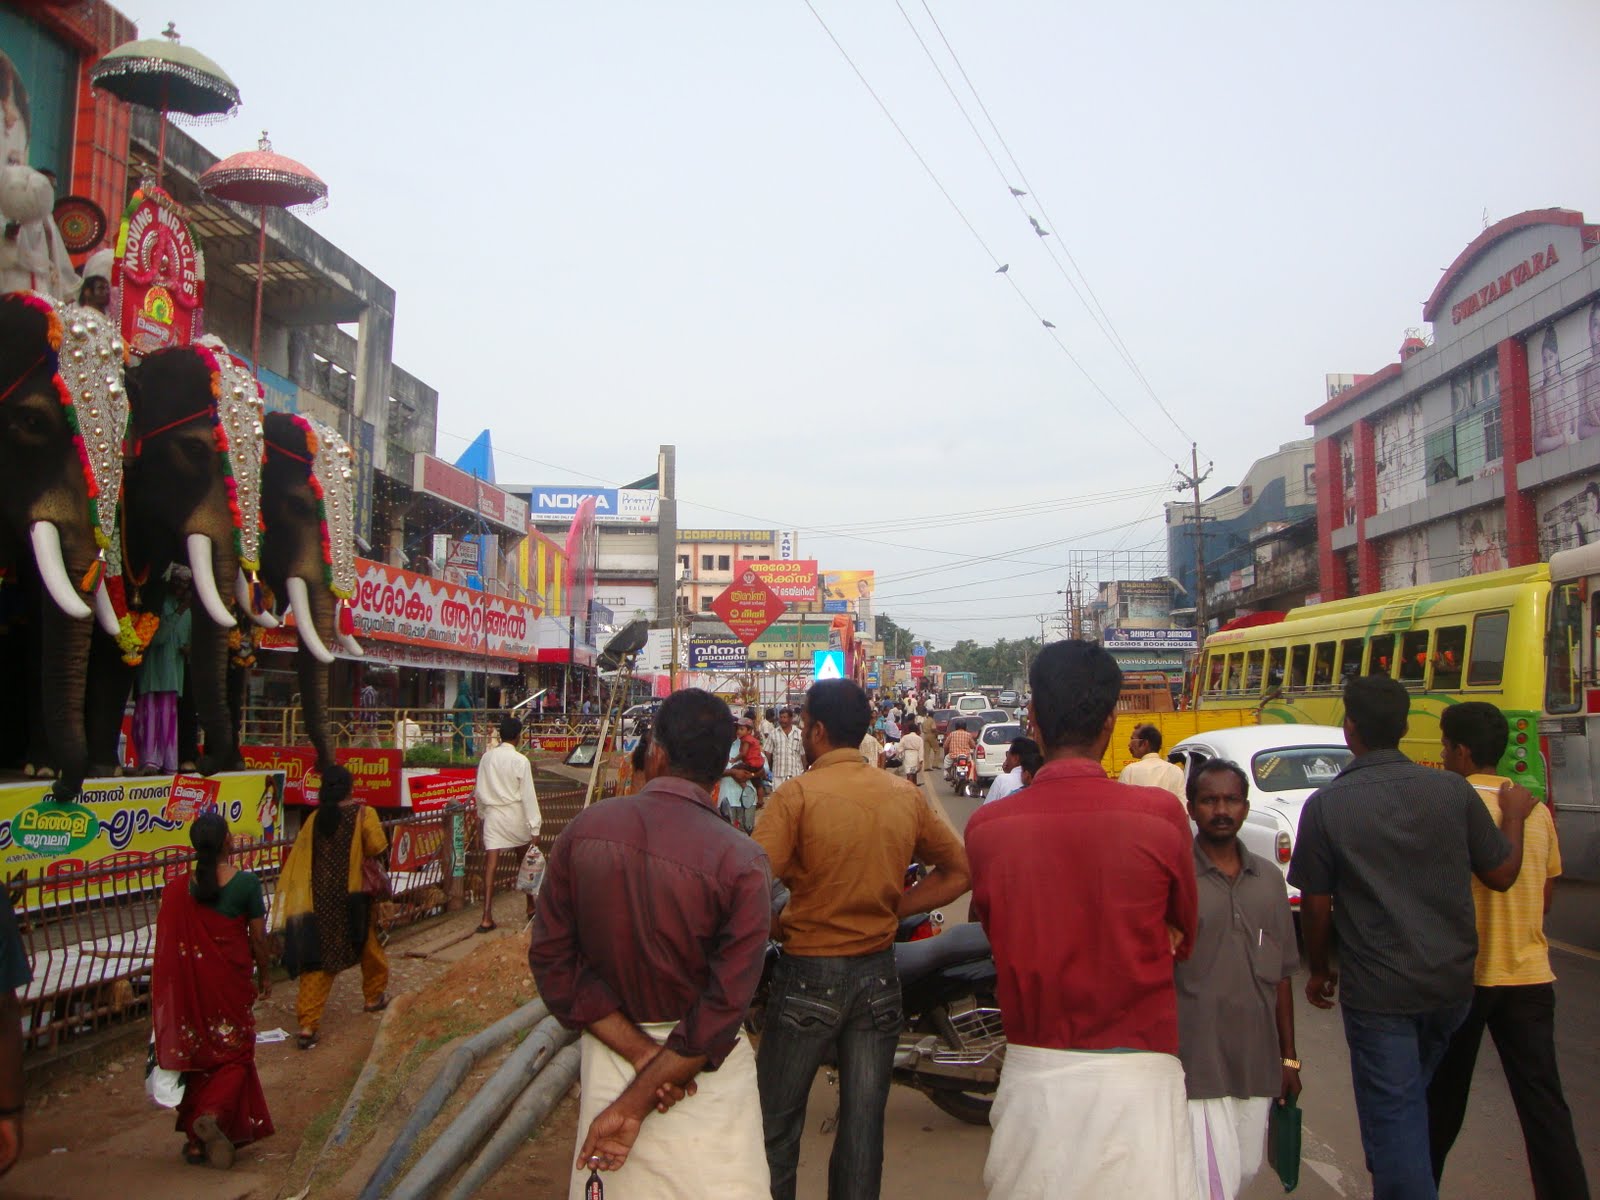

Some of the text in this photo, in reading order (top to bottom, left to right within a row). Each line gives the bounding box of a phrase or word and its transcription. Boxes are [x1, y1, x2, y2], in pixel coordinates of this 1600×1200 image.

[125, 206, 195, 296] MOVING MIRACLES
[1451, 243, 1560, 326] SWAYAMVARA
[538, 493, 610, 509] NOKA
[684, 530, 771, 541] CORPORATION
[781, 532, 791, 560] TAND
[1148, 657, 1183, 665] BOOKHOU
[23, 832, 71, 849] ജുവലറി
